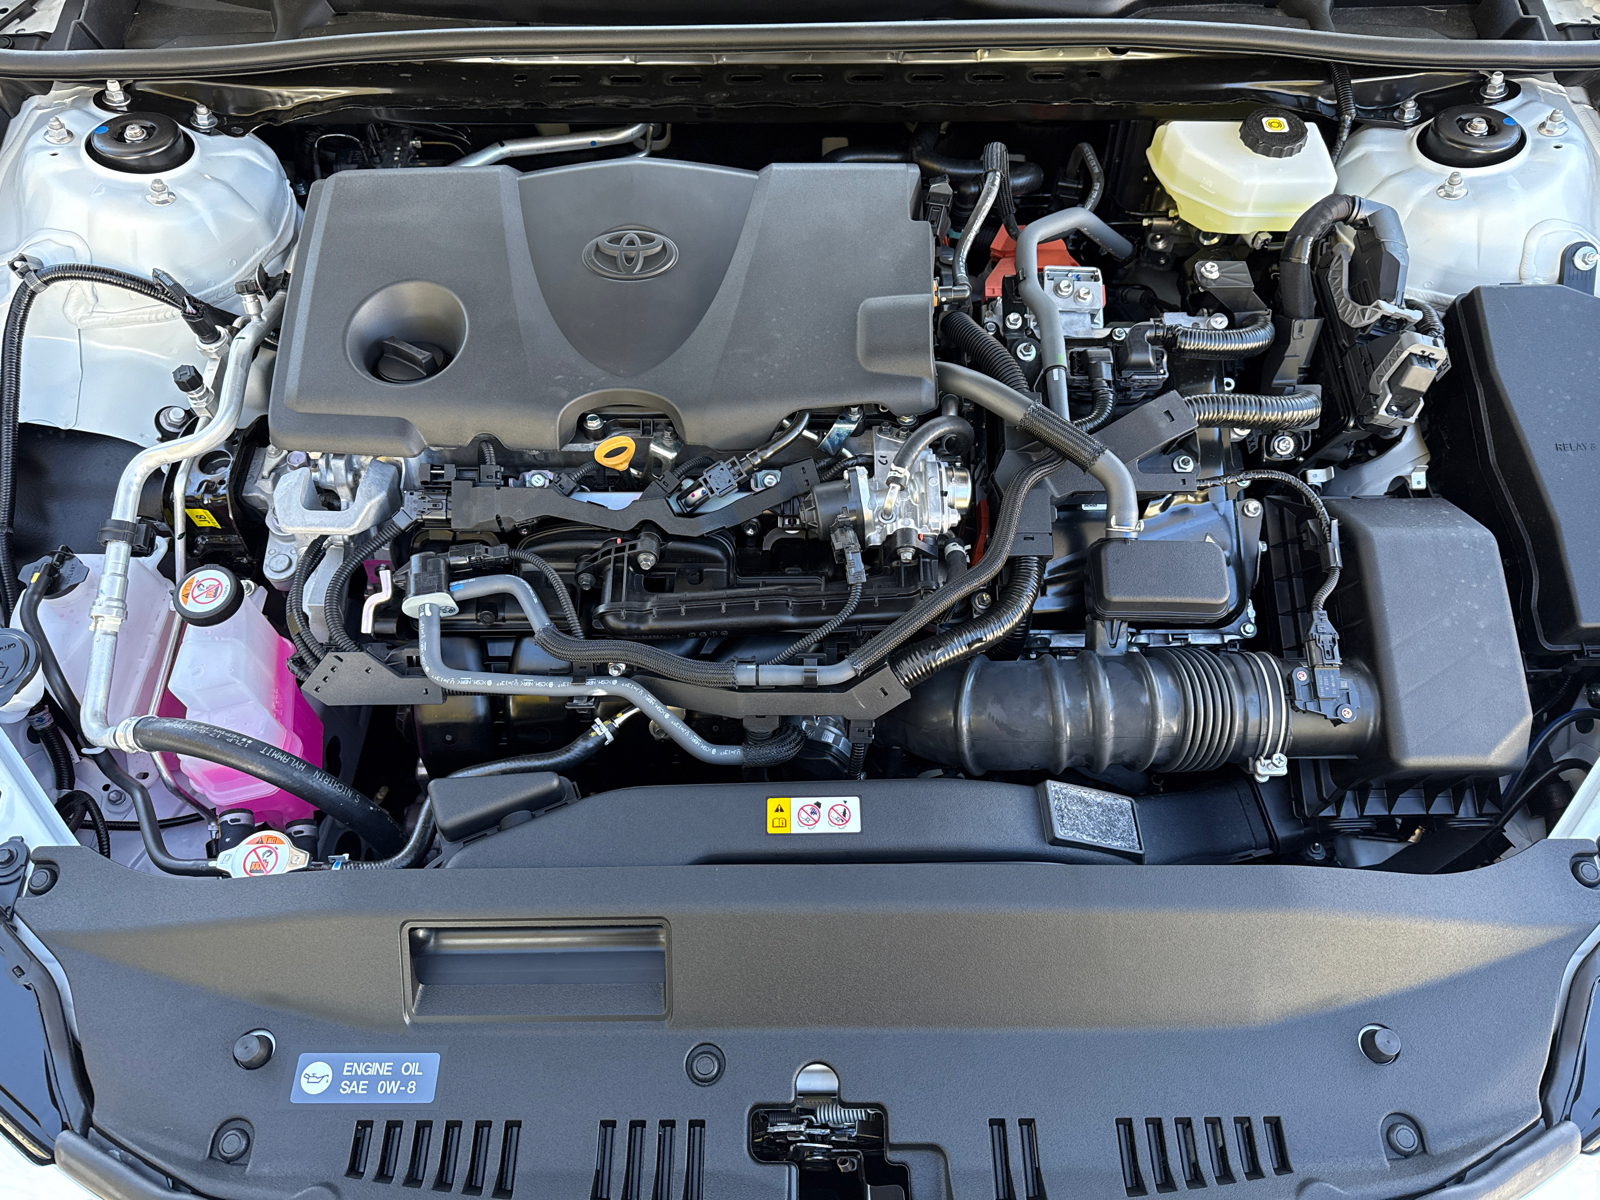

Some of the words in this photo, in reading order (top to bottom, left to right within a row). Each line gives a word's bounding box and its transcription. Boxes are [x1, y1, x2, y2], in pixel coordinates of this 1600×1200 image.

[1555, 442, 1587, 451] RELAY
[259, 746, 307, 772] HYLAMMIT
[343, 1062, 393, 1076] ENGINE
[401, 1062, 423, 1076] OIL
[340, 1080, 369, 1094] SAE
[377, 1080, 417, 1094] 0W-8
